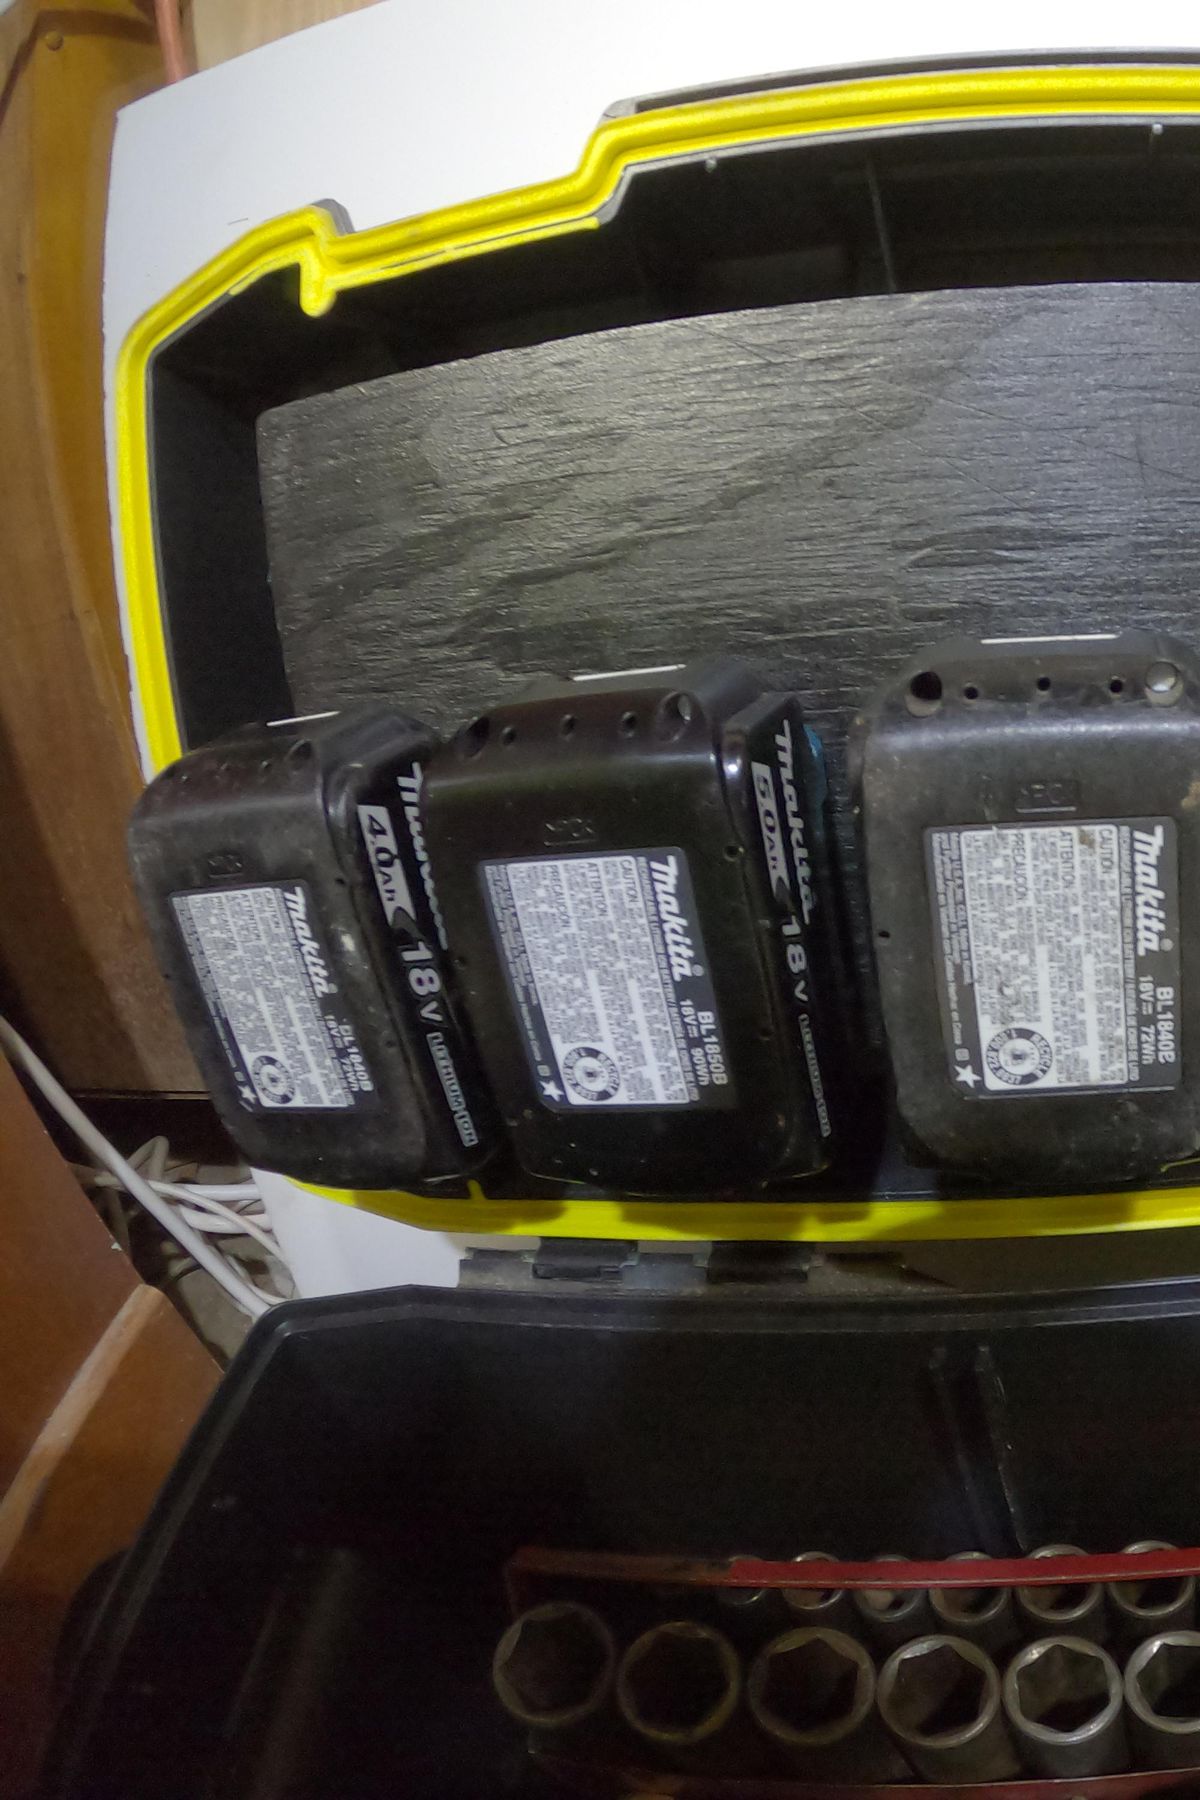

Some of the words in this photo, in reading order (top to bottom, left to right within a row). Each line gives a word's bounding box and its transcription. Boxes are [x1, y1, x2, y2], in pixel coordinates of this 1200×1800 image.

[697, 1011, 728, 1085] BL1850B
[1140, 1025, 1154, 1065] 72Wh
[690, 1047, 709, 1086] 90Wh
